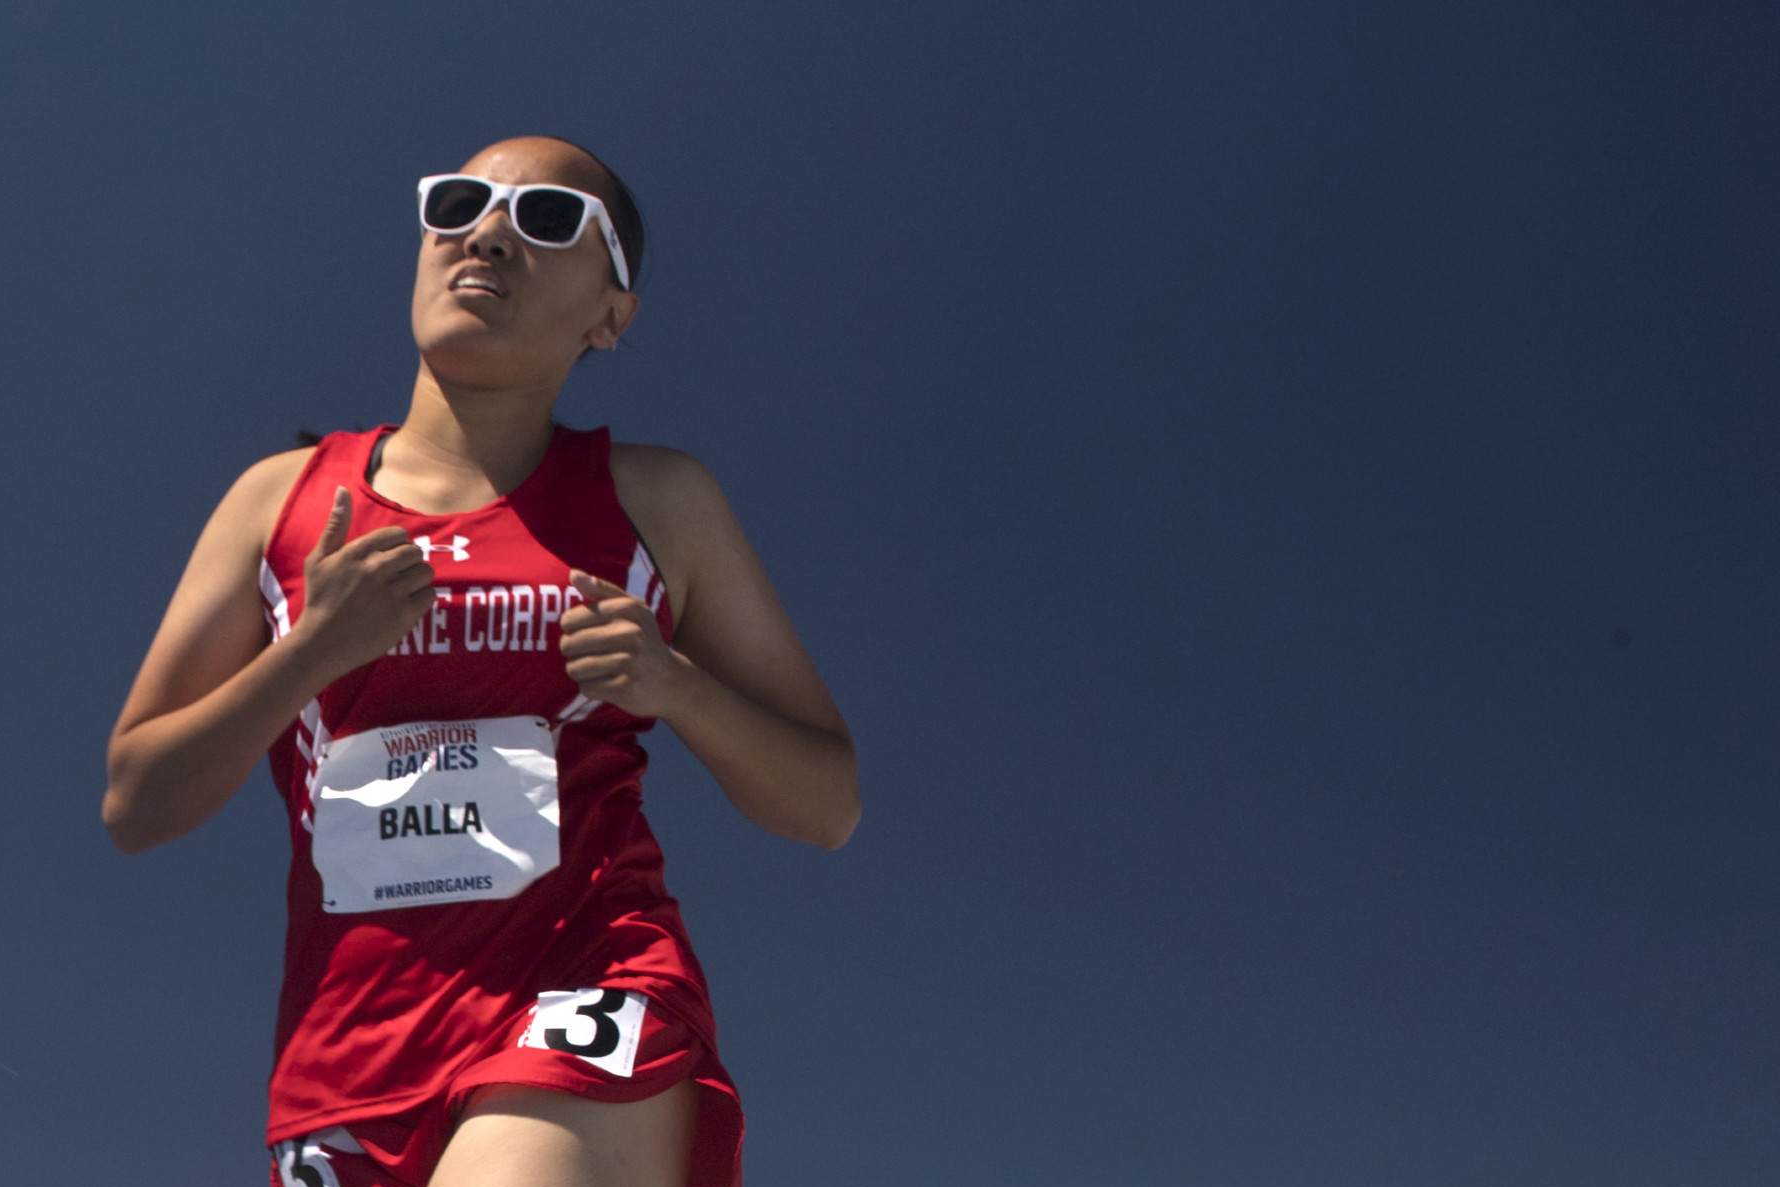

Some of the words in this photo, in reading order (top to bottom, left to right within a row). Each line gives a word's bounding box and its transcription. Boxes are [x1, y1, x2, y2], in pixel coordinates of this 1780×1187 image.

[384, 728, 477, 759] WARRIOR
[380, 802, 483, 841] BALLA
[374, 876, 493, 900] #WARRIORGAMES
[544, 989, 627, 1058] 3
